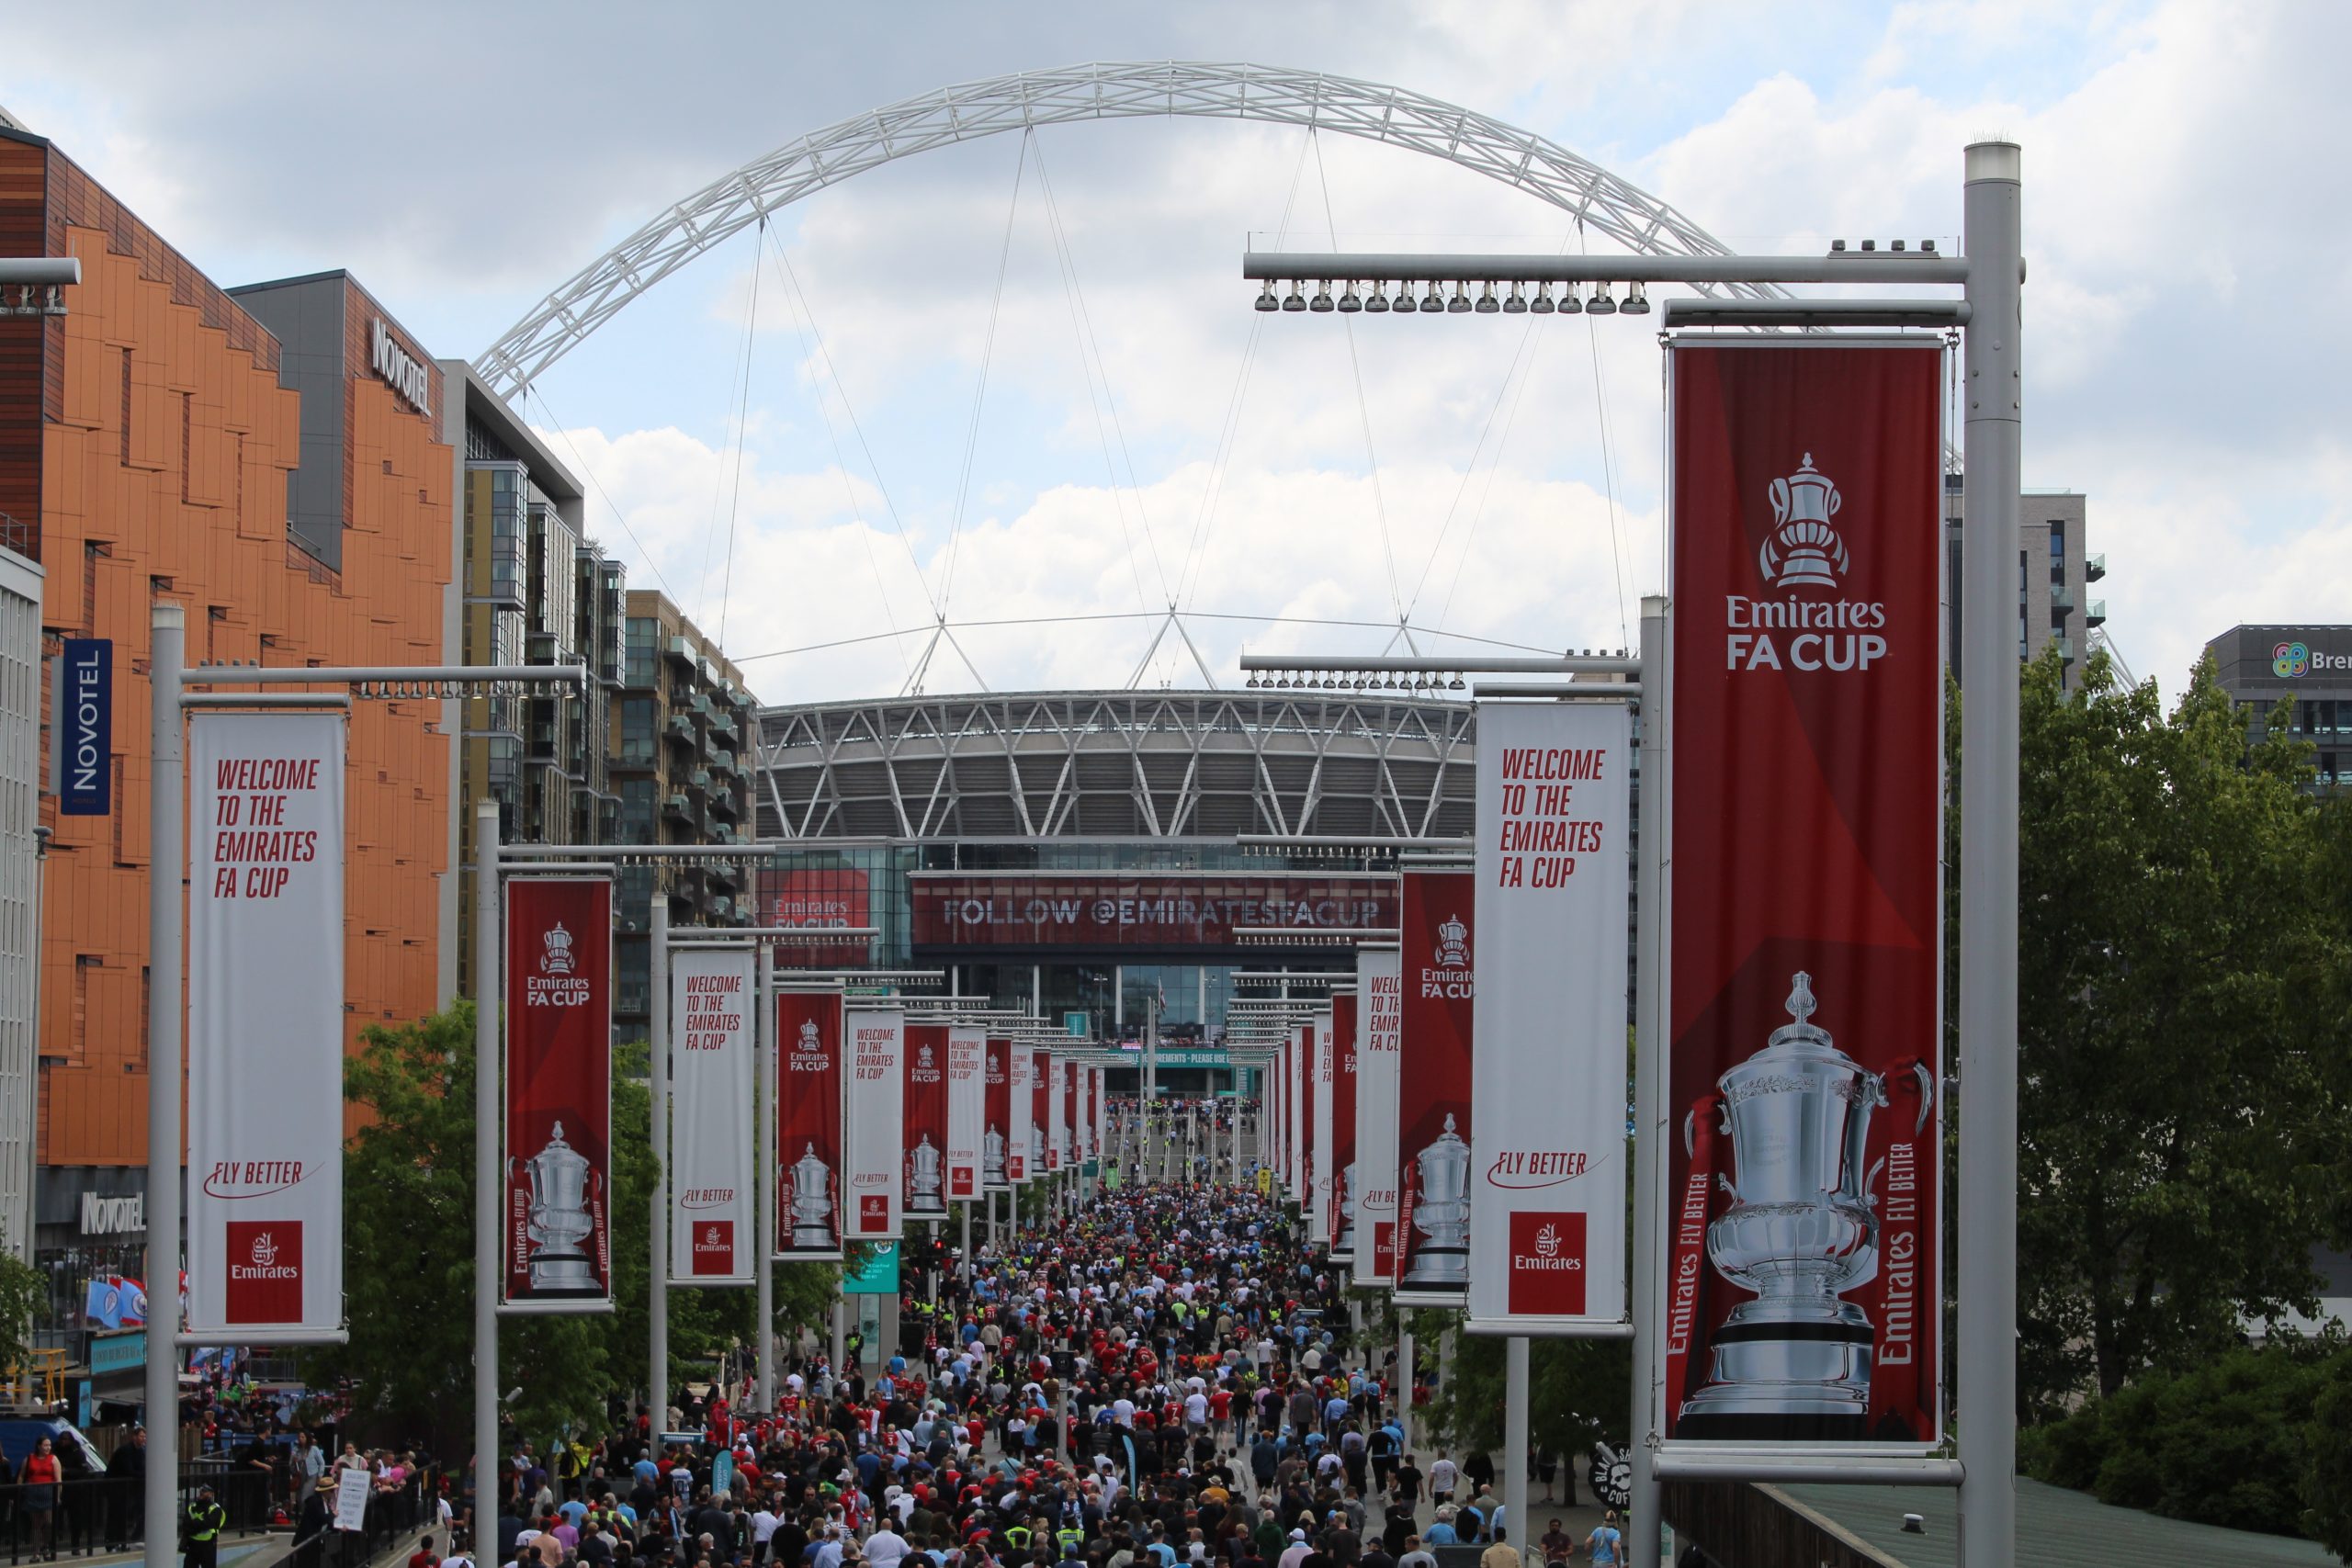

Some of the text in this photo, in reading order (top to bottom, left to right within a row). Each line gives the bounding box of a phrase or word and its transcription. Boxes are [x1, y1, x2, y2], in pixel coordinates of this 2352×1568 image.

[373, 317, 431, 418] NOVOTEL
[1726, 594, 1885, 628] Emirates
[1727, 633, 1887, 671] FA CUP
[74, 649, 99, 790] NOVOTEL
[1502, 749, 1606, 780] WELCOME
[217, 759, 320, 790] WELCOME
[1502, 784, 1573, 816] TO THE
[216, 795, 288, 826] TO THE
[1499, 820, 1603, 852] EMIRATES
[214, 830, 317, 862] EMIRATES
[1499, 856, 1576, 888] FA CUP
[214, 867, 289, 898] FA CUP
[774, 898, 847, 916] Emirates
[944, 899, 1378, 926] FOLLOW @EMIRATESFACUP
[527, 976, 589, 990] Emirates
[1421, 968, 1474, 982] Emirat
[686, 976, 741, 992] WELCOME
[1421, 984, 1473, 998] FA CU
[527, 991, 590, 1007] FA CUP
[686, 995, 725, 1011] TO THE
[1371, 996, 1385, 1012] TO
[686, 1014, 741, 1031] EMIRATES
[1370, 1015, 1399, 1032] EMIR
[685, 1033, 726, 1050] FA CUP
[857, 1029, 895, 1040] WELCOME
[1369, 1034, 1383, 1051] FA
[857, 1042, 883, 1054] TO THE
[951, 1041, 980, 1050] WELCOME
[790, 1052, 829, 1061] Emirates
[856, 1055, 894, 1066] EMIRATES
[951, 1051, 970, 1060] TO THE
[1191, 1055, 1214, 1063] PLEASE
[791, 1062, 830, 1071] FA CUP
[856, 1067, 884, 1079] FA CUP
[950, 1060, 979, 1070] EMIRATES
[950, 1070, 971, 1079] FA CUP
[1498, 1152, 1587, 1175] FLY BETTER
[213, 1162, 302, 1184] FLY BETTER
[855, 1174, 888, 1183] FLY BETTER
[685, 1190, 734, 1202] FLY BETTER
[1368, 1190, 1383, 1202] FLY
[81, 1191, 147, 1235] NOVOTEL
[514, 1221, 527, 1274] Emirates
[1396, 1220, 1409, 1259] Emirates
[597, 1231, 609, 1272] Emirates
[695, 1244, 731, 1252] Emirates
[1879, 1143, 1916, 1366] Emirates FLY BETTER
[1515, 1255, 1581, 1270] Emirates
[1668, 1173, 1708, 1356] Emirates FLY BETTER
[232, 1264, 298, 1280] Emirates
[1171, 1407, 1178, 1416] 7
[888, 1437, 894, 1446] 3
[1608, 1490, 1631, 1505] COF
